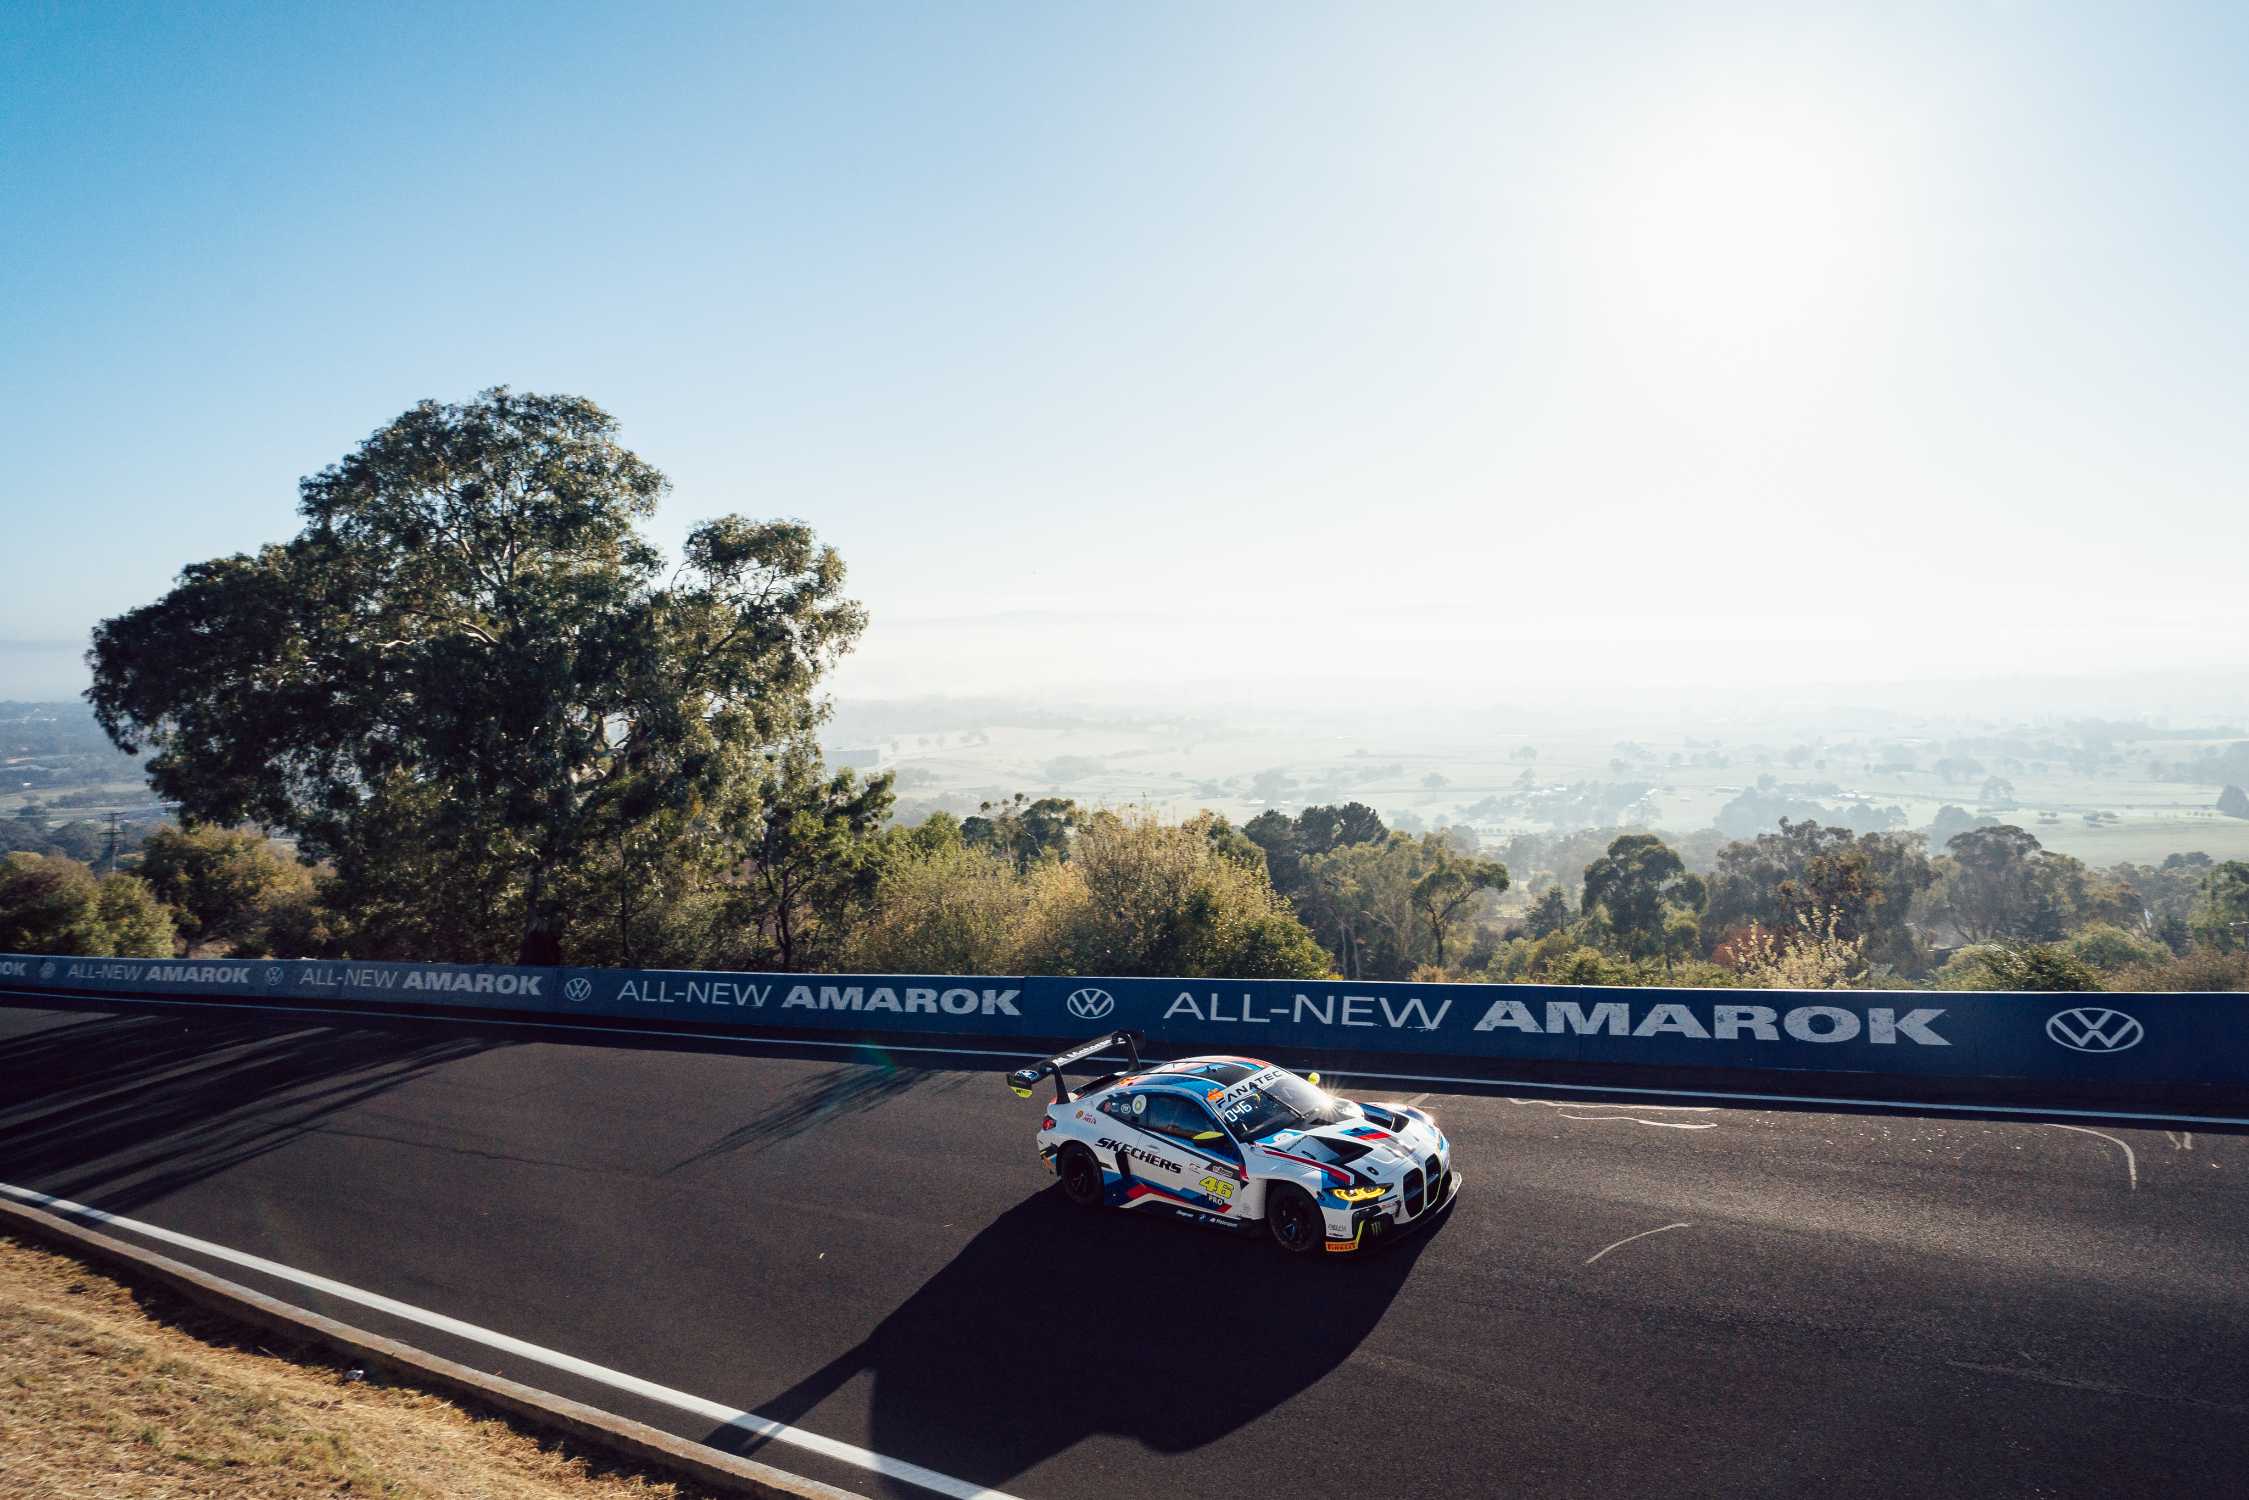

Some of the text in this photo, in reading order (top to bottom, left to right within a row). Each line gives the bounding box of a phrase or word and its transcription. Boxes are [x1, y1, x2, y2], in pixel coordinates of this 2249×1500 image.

[0, 961, 27, 977] OK
[67, 964, 250, 983] ALL-NEW AMAROK
[299, 968, 543, 995] ALL-NEW AMAROK
[617, 980, 1022, 1016] ALL-NEW AMAROK
[1163, 992, 1952, 1046] ALL-NEW AMAROK
[1216, 1070, 1283, 1108] FANATEC
[1224, 1100, 1253, 1122] 046
[1095, 1138, 1183, 1174] SKECHERS
[1199, 1176, 1234, 1199] 46
